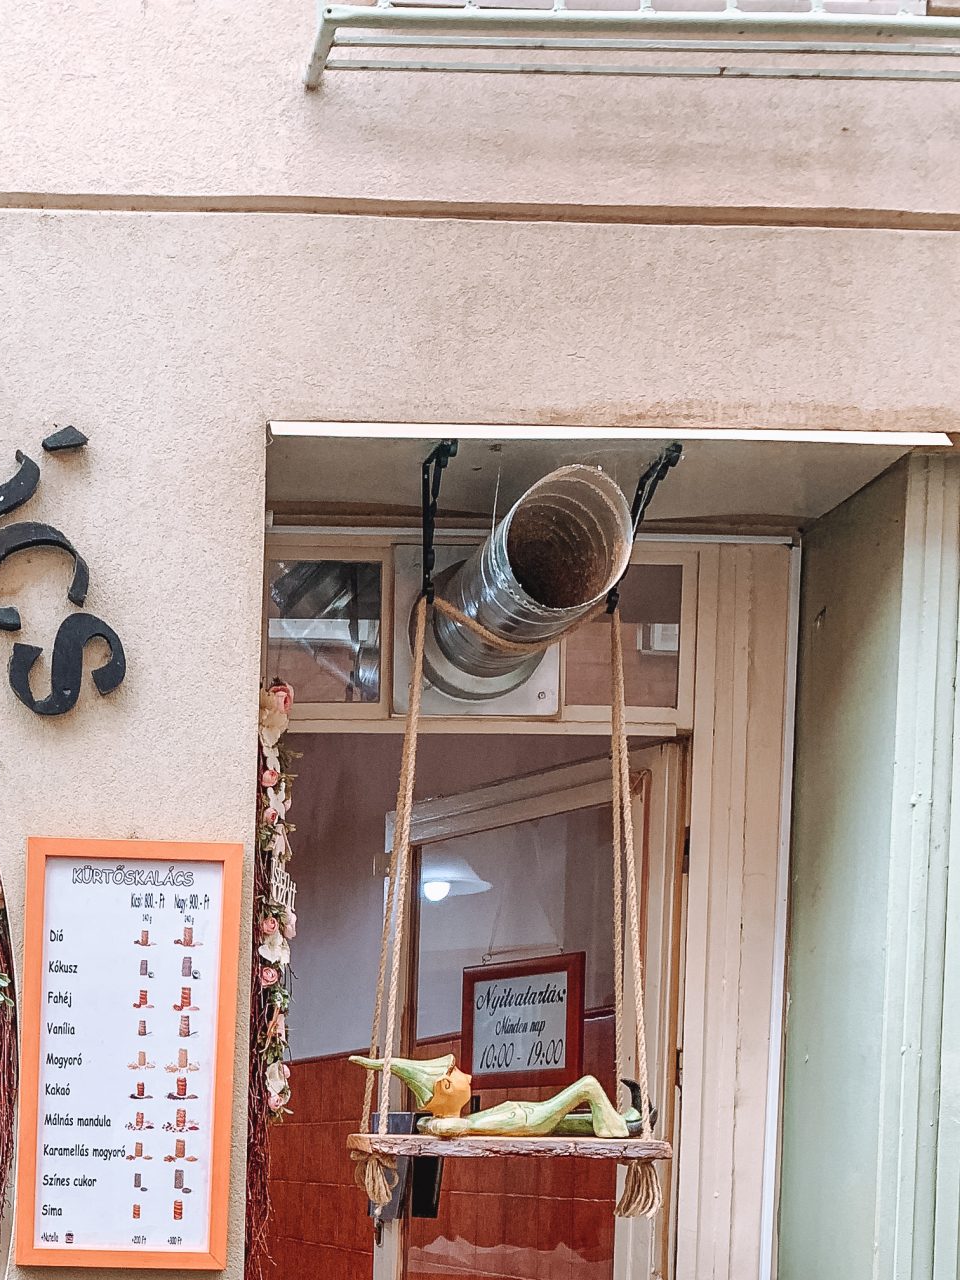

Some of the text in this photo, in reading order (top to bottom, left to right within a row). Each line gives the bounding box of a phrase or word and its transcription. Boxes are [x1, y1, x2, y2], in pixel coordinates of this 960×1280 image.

[72, 865, 195, 887] KÜRTŐSKALÁCS
[49, 929, 64, 942] Dió
[48, 960, 78, 974] Kókusz
[47, 991, 72, 1008] Fahéj
[47, 1022, 75, 1035] Vanília
[495, 1016, 546, 1037] Minden nap
[46, 1053, 83, 1069] Mogyoró
[480, 1043, 515, 1069] 10:00
[526, 1038, 564, 1066] 19:00
[45, 1083, 71, 1096] Kakaó
[44, 1113, 112, 1128] Málnás mandula
[43, 1144, 126, 1161] Karamellás mogyoró
[42, 1174, 97, 1187] Színes cukor
[41, 1205, 63, 1216] Sima
